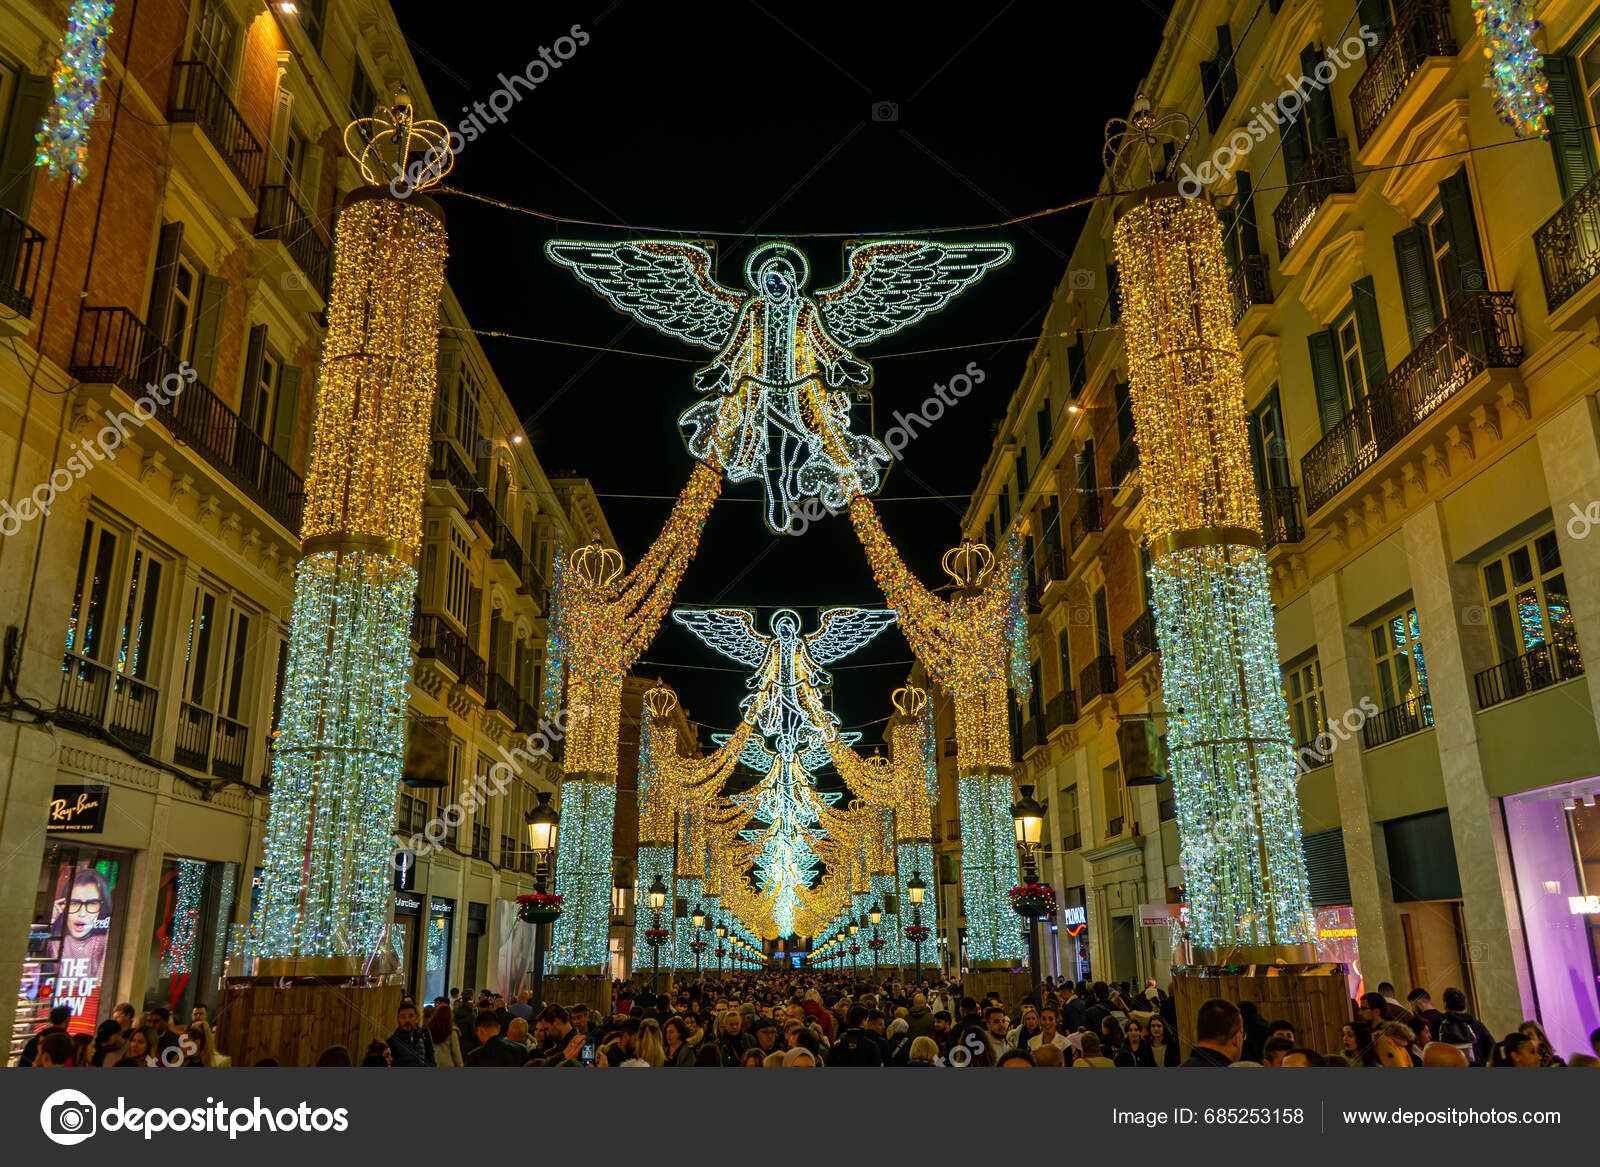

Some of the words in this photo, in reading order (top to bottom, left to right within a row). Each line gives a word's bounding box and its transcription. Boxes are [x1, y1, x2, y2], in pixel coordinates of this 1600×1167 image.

[50, 793, 99, 821] Ray-Ban
[1064, 906, 1086, 925] PRIMOR
[61, 958, 90, 977] THE
[78, 977, 98, 997] OF
